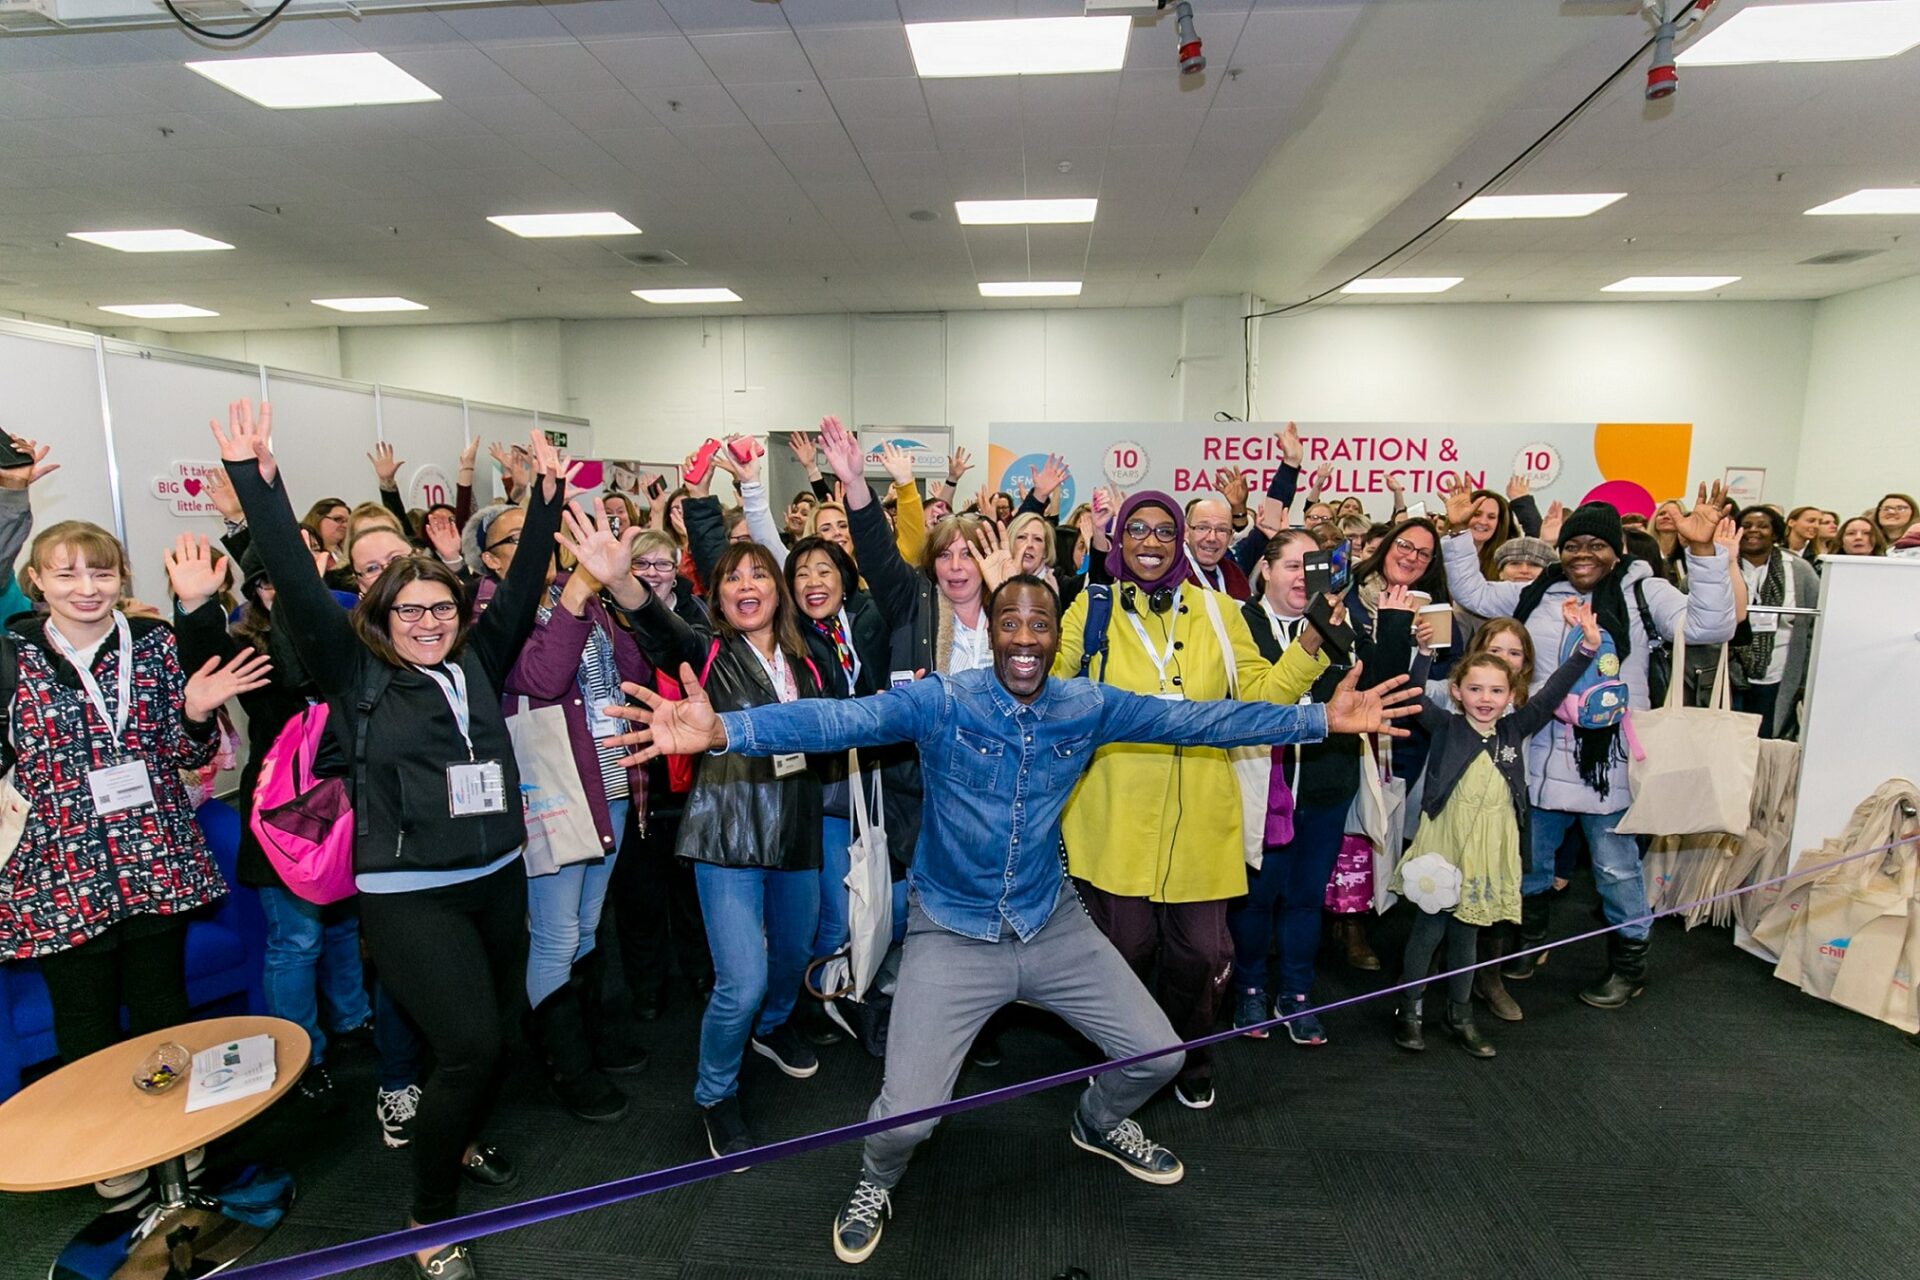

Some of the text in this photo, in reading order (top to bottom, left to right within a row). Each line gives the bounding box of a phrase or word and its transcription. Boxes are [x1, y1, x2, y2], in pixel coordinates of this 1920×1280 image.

[1438, 438, 1459, 462] &
[917, 454, 946, 466] expo
[1113, 450, 1138, 468] 10
[1525, 452, 1551, 471] 10
[179, 464, 217, 477] It take
[1111, 470, 1139, 479] YEARS
[158, 481, 179, 494] BIG
[423, 485, 445, 509] 10
[177, 500, 202, 511] little
[530, 795, 566, 812] expo
